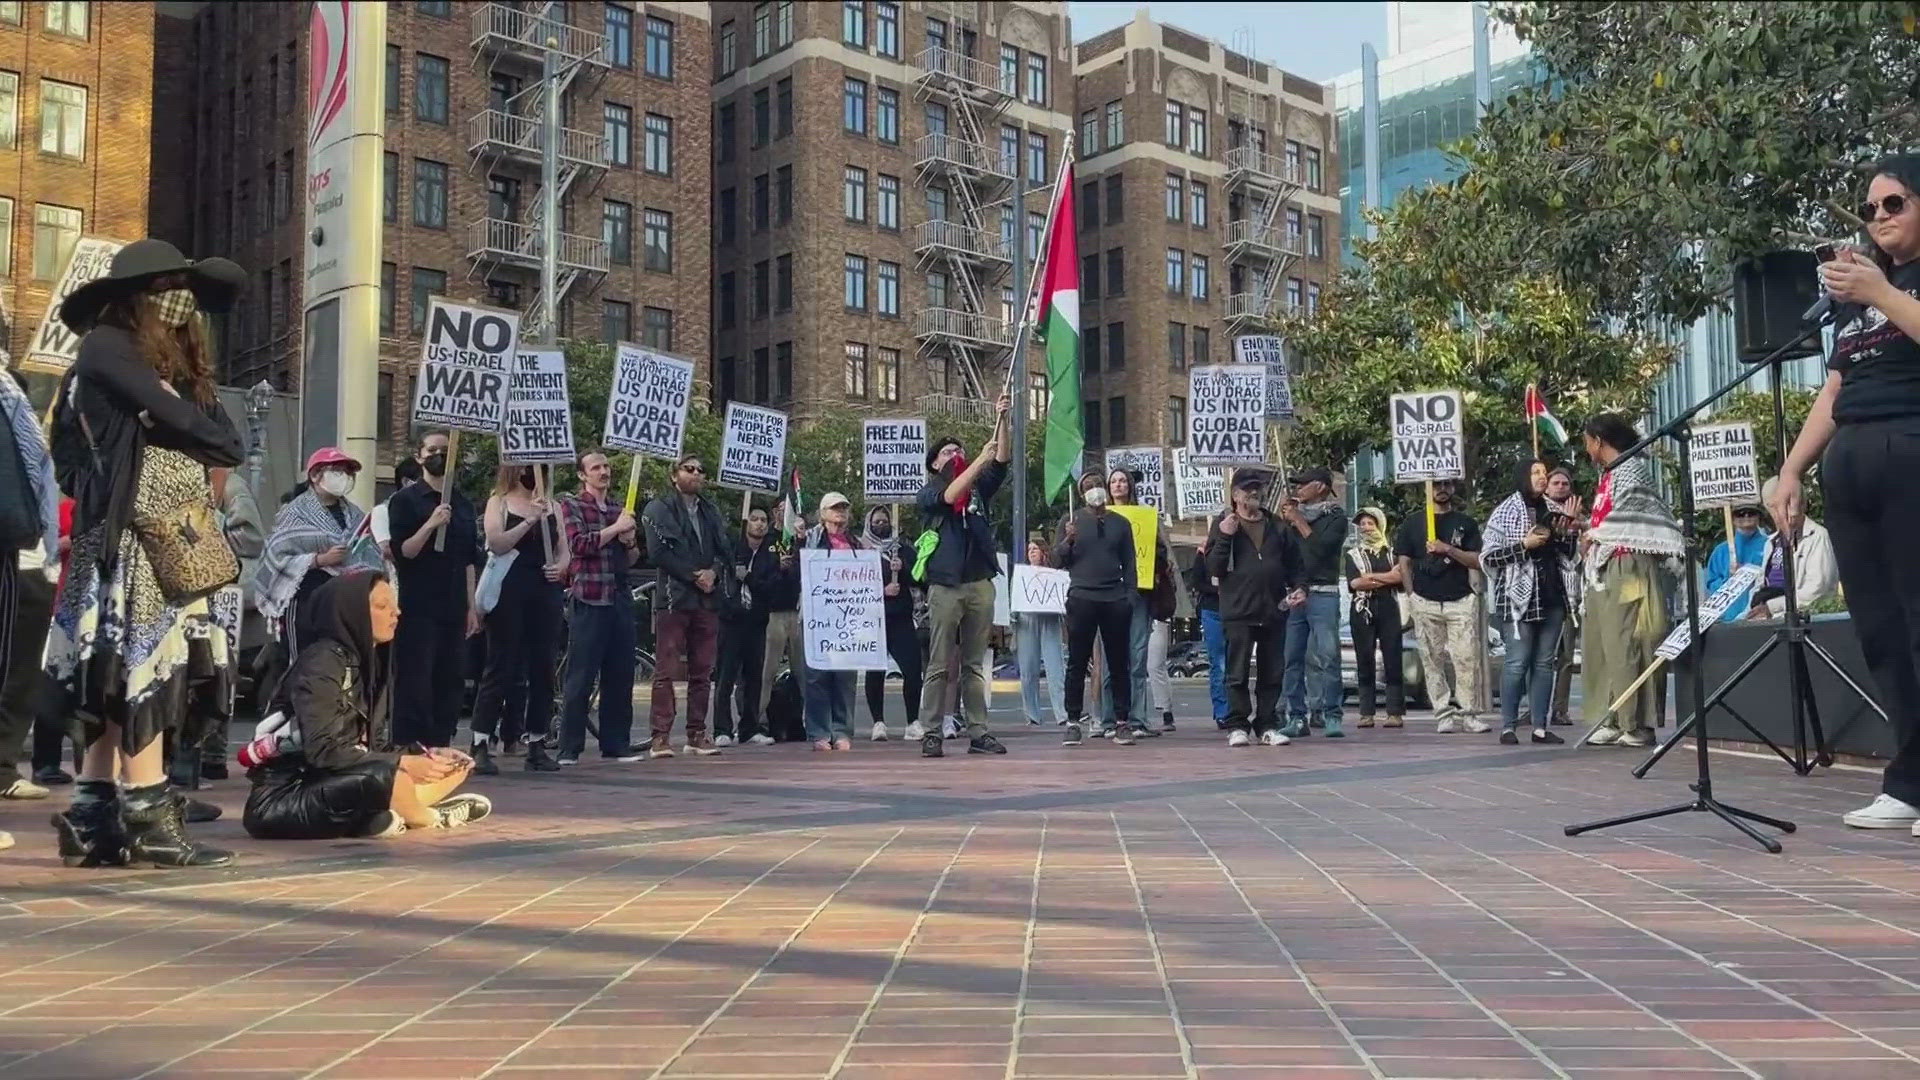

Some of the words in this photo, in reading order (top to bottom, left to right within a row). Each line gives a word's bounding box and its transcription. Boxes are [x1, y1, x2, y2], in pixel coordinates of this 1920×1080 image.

[430, 306, 511, 354] NO
[1242, 339, 1263, 350] END
[1266, 339, 1279, 350] THE
[428, 345, 506, 371] US-ISRAEL
[517, 355, 540, 371] THE
[1245, 351, 1260, 362] US
[1263, 351, 1280, 363] WAR
[621, 357, 637, 368] WE
[672, 369, 689, 381] LET
[426, 364, 503, 403] WAR
[621, 366, 647, 384] YOU
[651, 374, 686, 392] DRAG
[1193, 377, 1209, 386] WE
[1245, 377, 1261, 386] LET
[618, 378, 640, 398] US
[645, 385, 685, 408] INTO
[1194, 387, 1220, 398] YOU
[1225, 387, 1261, 398] DRAG
[420, 394, 445, 412] ON
[450, 400, 500, 420] IRAN!
[614, 399, 680, 426] GLOBAL
[1194, 399, 1216, 413] US
[1222, 399, 1262, 414] INTO
[1396, 395, 1455, 424] NO
[732, 408, 765, 421] MONEY
[766, 415, 783, 426] FOR
[1193, 417, 1260, 432] GLOBAL
[612, 413, 679, 448] WAR!
[730, 419, 783, 438] PEOPLE'S
[866, 425, 898, 440] FREE
[901, 425, 924, 440] ALL
[1725, 428, 1751, 444] ALL
[503, 427, 520, 450] IS
[523, 426, 569, 449] FREE!
[737, 431, 774, 448] NEEDS
[1192, 433, 1260, 453] WAR!
[727, 447, 753, 462] NOT
[757, 452, 779, 468] THE
[866, 443, 925, 454] PALESTINIAN
[1398, 437, 1457, 460] WAR
[1692, 445, 1751, 461] PALESTINIAN
[866, 463, 923, 477] POLITICAL
[1399, 460, 1417, 472] ON
[1422, 457, 1459, 470] IRAN!
[1694, 464, 1753, 484] POLITICAL
[866, 479, 924, 491] PRISONERS
[1695, 479, 1754, 497] PRISONERS
